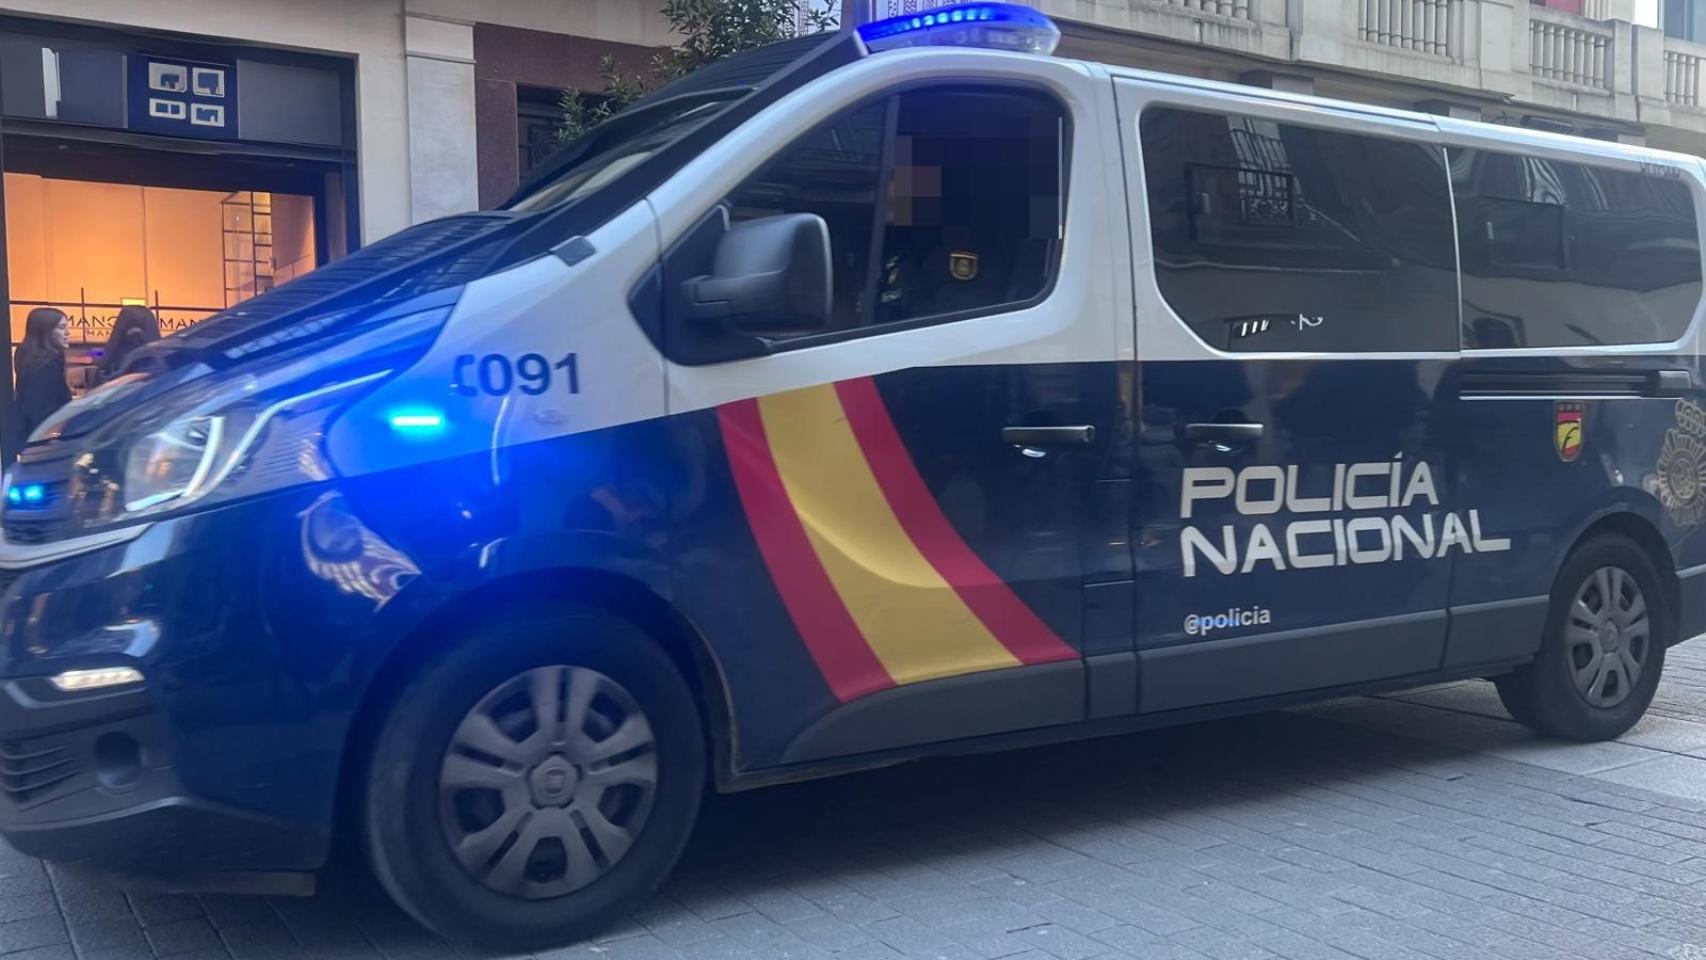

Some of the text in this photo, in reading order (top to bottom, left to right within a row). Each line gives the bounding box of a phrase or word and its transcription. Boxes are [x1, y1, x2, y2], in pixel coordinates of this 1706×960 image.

[1180, 452, 1439, 518] POLICÍA
[1180, 509, 1511, 577] NACIONAL
[1184, 606, 1271, 635] @policia
